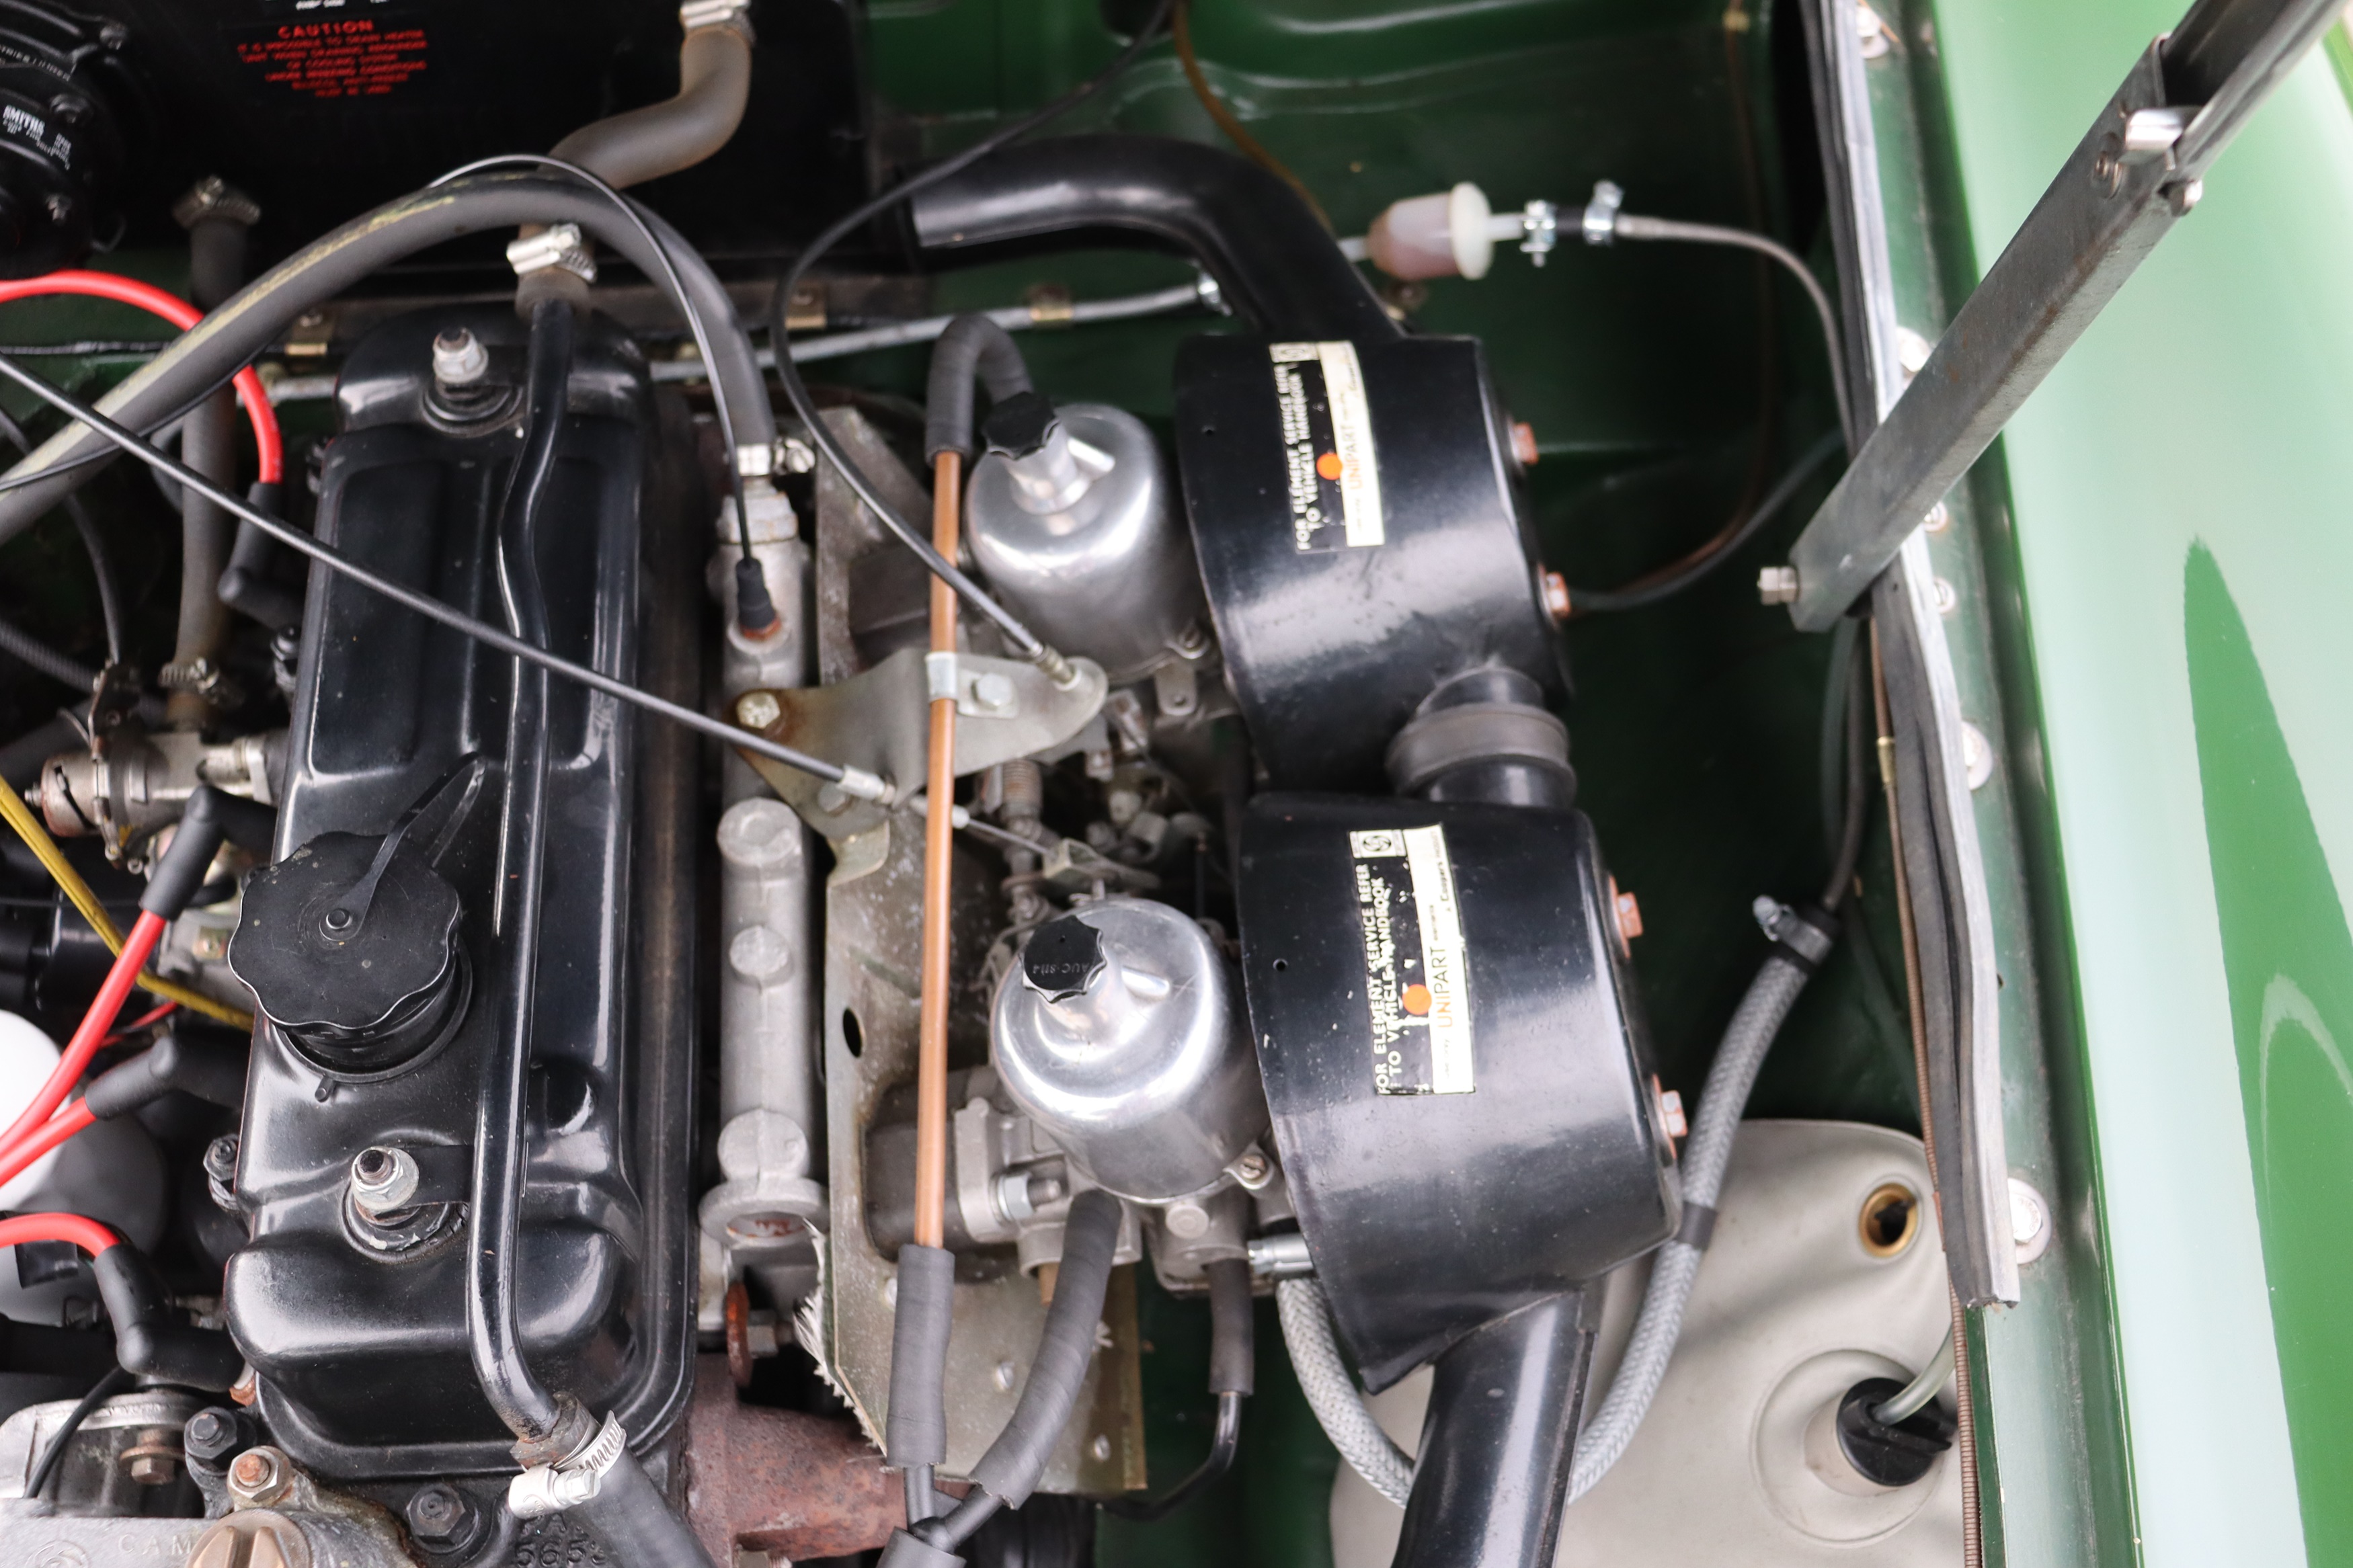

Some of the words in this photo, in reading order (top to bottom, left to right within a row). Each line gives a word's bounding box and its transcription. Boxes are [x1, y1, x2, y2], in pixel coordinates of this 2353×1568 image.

[278, 19, 373, 39] CAUTION
[3, 105, 45, 136] SMITHS
[1278, 395, 1300, 445] SERVICE
[1341, 423, 1363, 490] UNIPART
[1286, 448, 1308, 513] ELEMENT
[1295, 518, 1312, 550] FOR
[1355, 864, 1374, 903] REFER
[1436, 860, 1450, 902] Coopers
[1361, 909, 1380, 973] SERVICE
[1430, 946, 1453, 1029] UNIPART
[1367, 977, 1388, 1055] ELEMENT
[1375, 1063, 1392, 1095] FOR
[1388, 1050, 1403, 1077] TO
